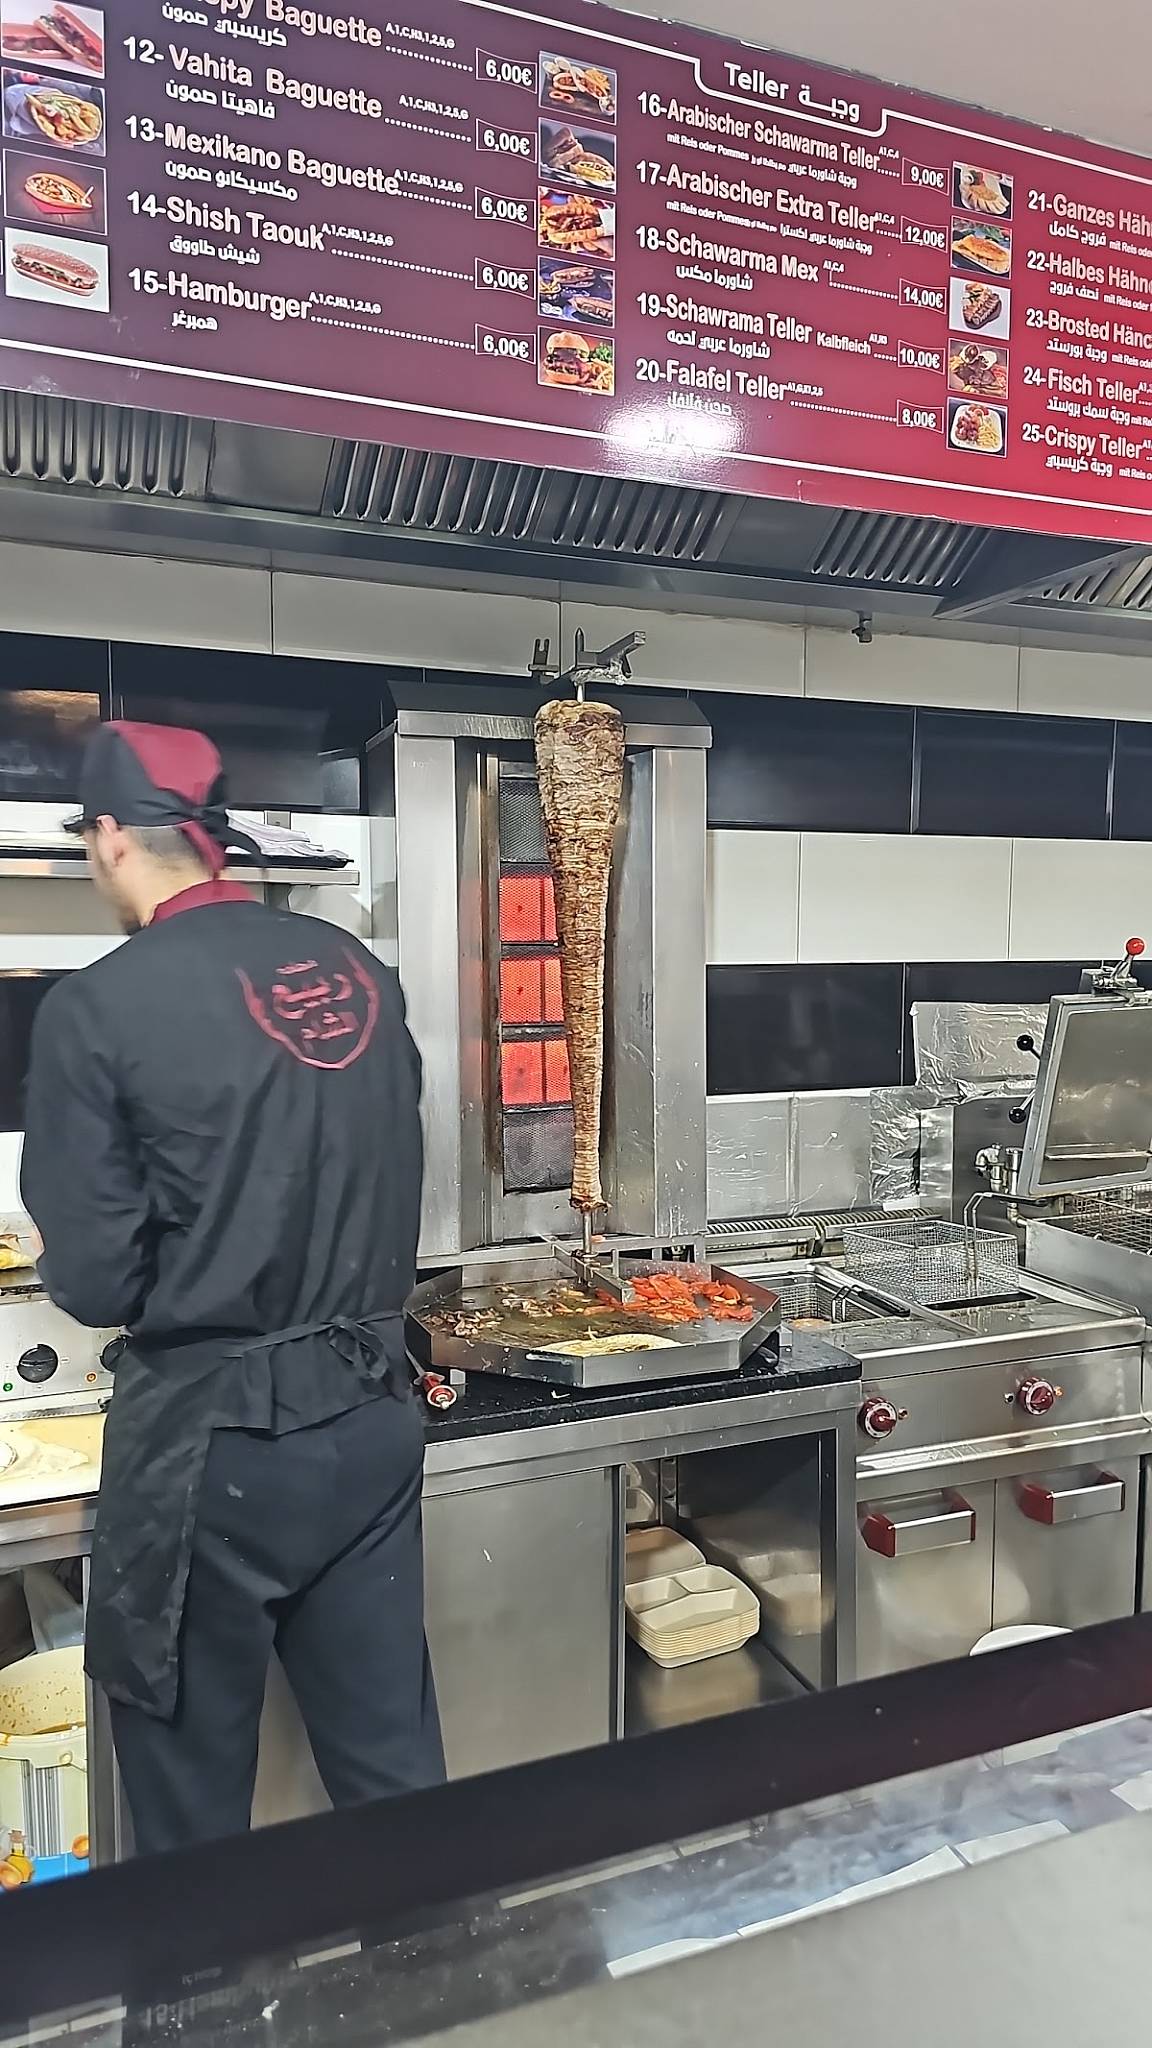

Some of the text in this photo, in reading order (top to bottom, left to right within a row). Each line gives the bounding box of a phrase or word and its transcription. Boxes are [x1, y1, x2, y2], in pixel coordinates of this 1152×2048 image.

[161, 2, 209, 26] صمون
[265, 0, 382, 47] Baguette
[485, 59, 533, 86] 6,00€
[723, 61, 789, 100] Teller
[165, 79, 276, 119] فاهيتا صمون
[168, 44, 253, 86] Vahita
[266, 68, 382, 118] Baguette
[484, 129, 531, 156] 6,00€
[798, 84, 860, 123] وجبة
[637, 91, 751, 139] 16-Arabischer
[754, 120, 838, 161] Schawarma
[840, 142, 880, 171] Teller
[910, 166, 945, 188] 9,00€
[666, 133, 749, 160] mit Reis oder Pommes
[125, 115, 281, 170] 13-Mexikano
[287, 149, 399, 196] Baguette
[481, 197, 528, 222] 6,00€
[165, 160, 212, 182] صمون
[636, 160, 772, 208] 17-Arabischer
[776, 188, 824, 221] Extra
[828, 201, 876, 232] Teller
[905, 226, 945, 248] 12,00€
[666, 201, 680, 212] mit
[680, 202, 697, 215] Reis
[698, 208, 716, 219] oder
[717, 211, 750, 228] Pommes
[1028, 190, 1152, 238] 21-Ganzes Häh
[127, 190, 240, 234] 14-Shish
[245, 211, 324, 251] Taouk
[482, 266, 529, 292] 6,00€
[1049, 221, 1107, 247] فروج كامل
[1109, 240, 1121, 251] mit
[1122, 242, 1137, 255] Reis
[218, 243, 261, 265] شيش
[636, 225, 777, 276] 18-Schawarma
[781, 254, 819, 282] Mex
[903, 286, 944, 309] 14,00€
[676, 265, 753, 291] شاورما مكس
[1027, 250, 1152, 294] 22-Halbes Hähn
[1050, 281, 1100, 300] نصف فروج
[1104, 294, 1149, 310] mit Reis oder
[128, 267, 312, 321] 15-Hamburger
[483, 334, 530, 359] 6,00€
[1026, 308, 1109, 341] 23-Brosted
[636, 292, 764, 335] 19-Schawrama
[766, 312, 813, 343] Teller
[816, 331, 871, 355] Kalbfleich
[900, 348, 940, 369] 10,00€
[729, 338, 770, 359] شاورما
[1085, 344, 1107, 363] وجبة
[1111, 353, 1123, 363] mit
[1124, 354, 1139, 367] Reis
[635, 358, 731, 393] 20-Falafel
[735, 371, 787, 401] Teller
[902, 409, 936, 428] 8,00€
[1096, 377, 1139, 404] Teller
[1110, 406, 1130, 426] وجبة
[1131, 416, 1142, 426] mit
[1022, 423, 1096, 456] 25-Crispy
[1099, 434, 1142, 459] Teller
[1090, 458, 1113, 477] وجبة
[1119, 468, 1130, 478] mit
[1131, 468, 1146, 479] Reis
